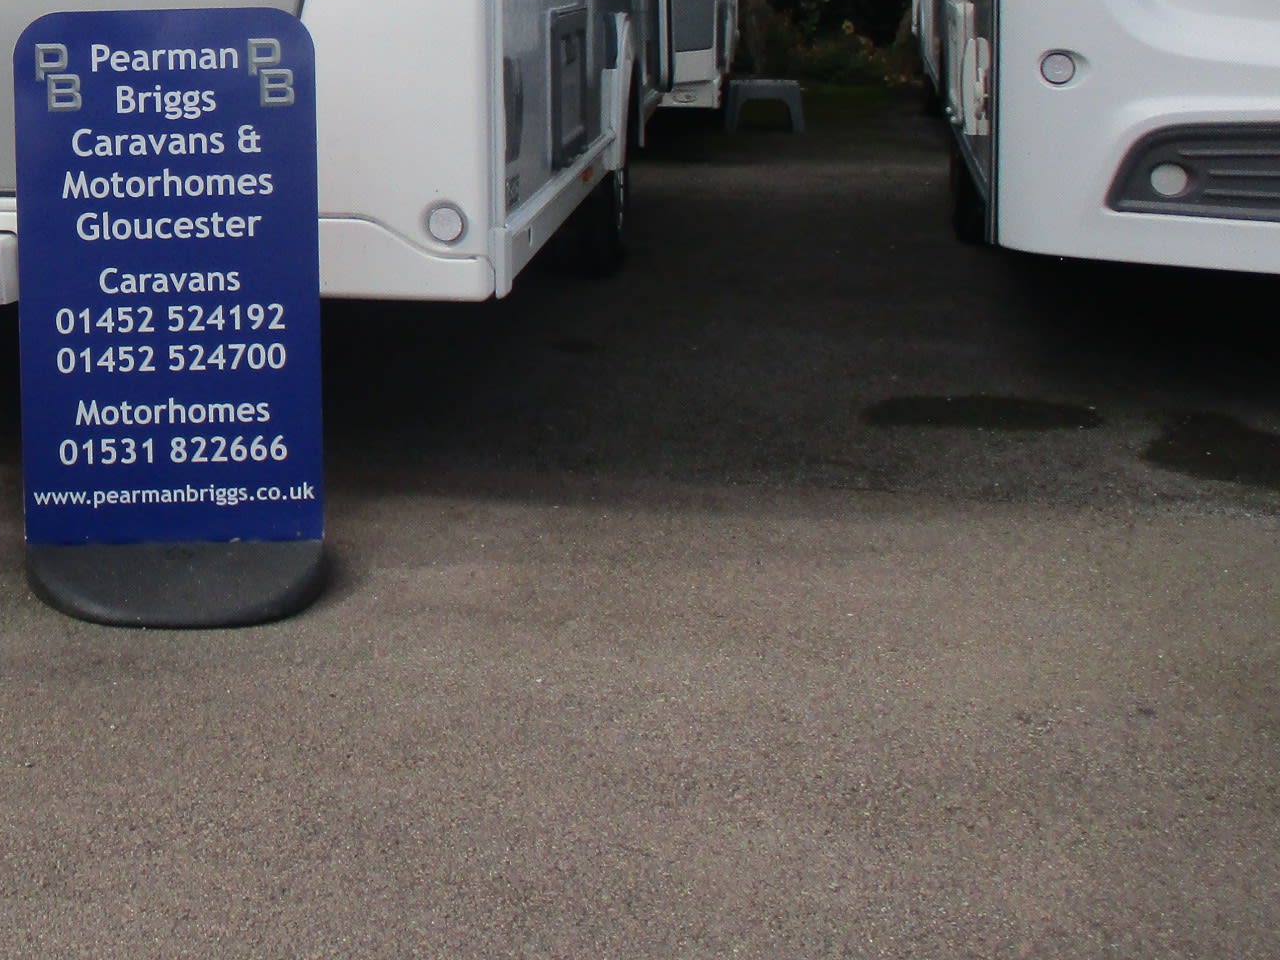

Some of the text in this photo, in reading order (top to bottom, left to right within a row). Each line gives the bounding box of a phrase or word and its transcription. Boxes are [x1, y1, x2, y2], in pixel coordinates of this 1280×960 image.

[91, 43, 239, 73] Pearman
[116, 84, 217, 120] Briggs
[71, 124, 262, 157] Caravans &
[62, 167, 274, 200] Motorhomes
[76, 211, 263, 241] Gloucester
[99, 267, 241, 294] Caravans
[55, 303, 286, 335] 01452 524192
[56, 342, 287, 374] 01452 524700
[75, 397, 271, 426] Motorhomes
[59, 434, 288, 466] 01531 822666
[33, 481, 315, 509] www.pearmanbriggs.co.uk
